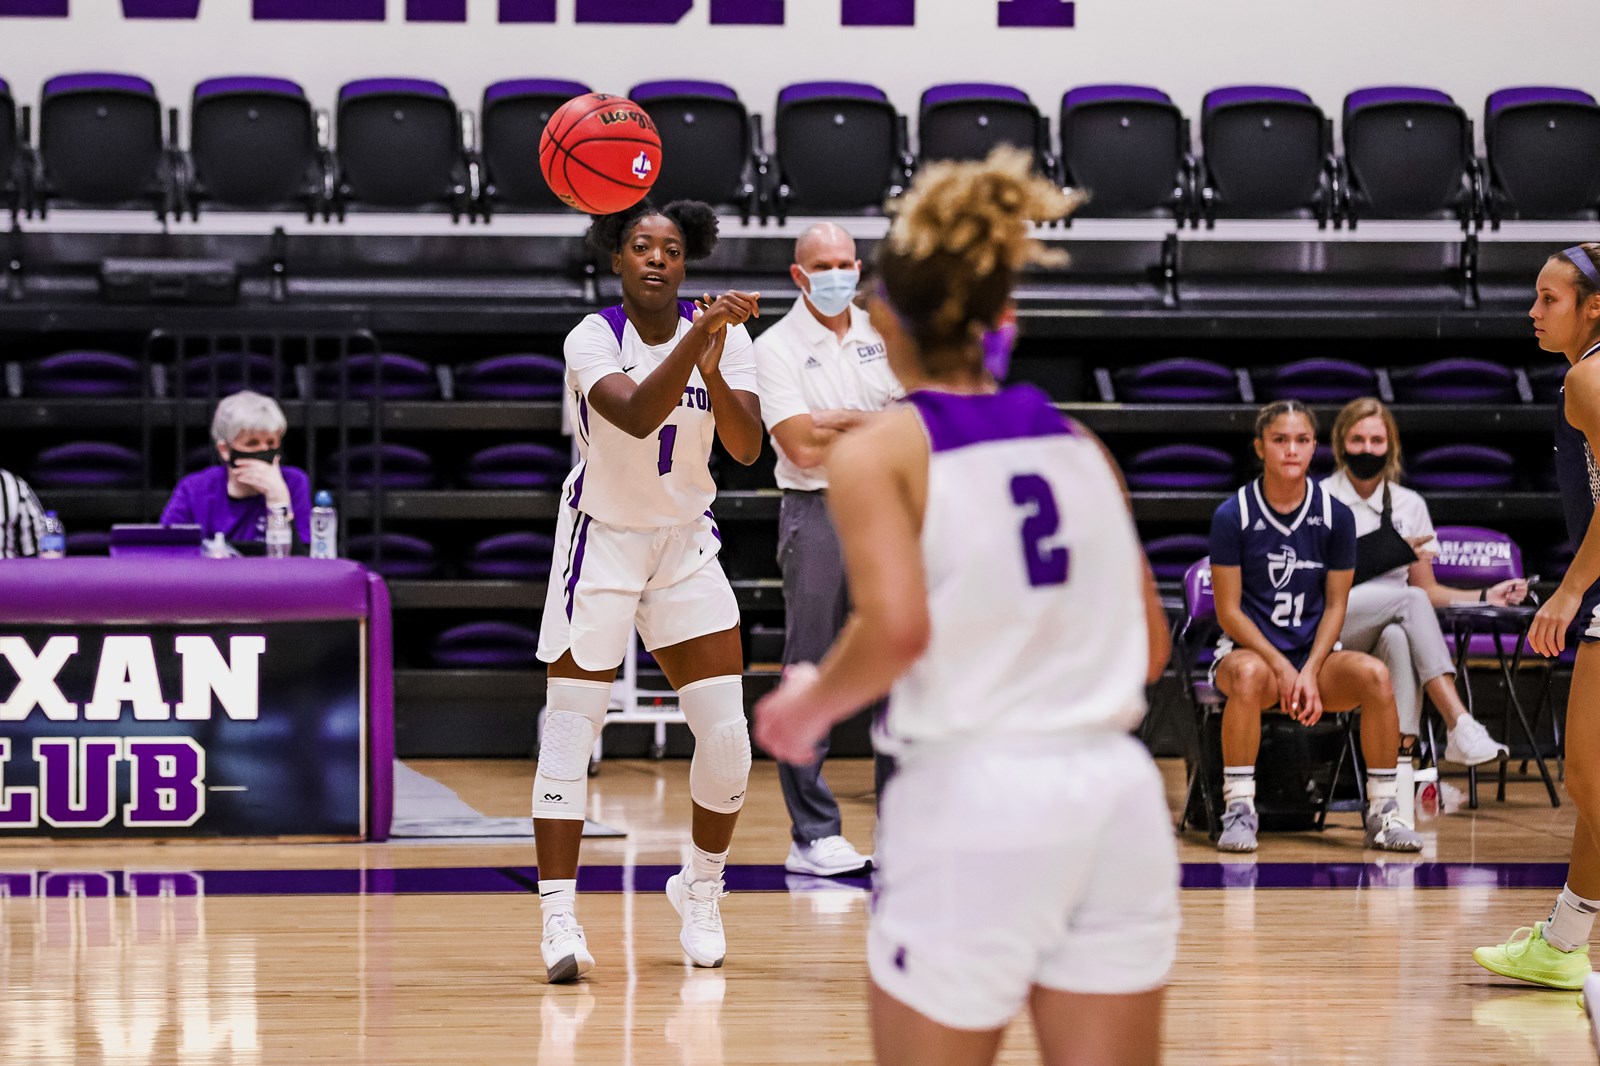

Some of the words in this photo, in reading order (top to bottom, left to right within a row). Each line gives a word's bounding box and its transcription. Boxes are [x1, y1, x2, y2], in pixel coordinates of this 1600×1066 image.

[857, 343, 884, 358] CBU
[657, 425, 678, 477] 1
[1009, 474, 1069, 587] 2
[1270, 592, 1306, 628] 21
[0, 635, 266, 721] XAN
